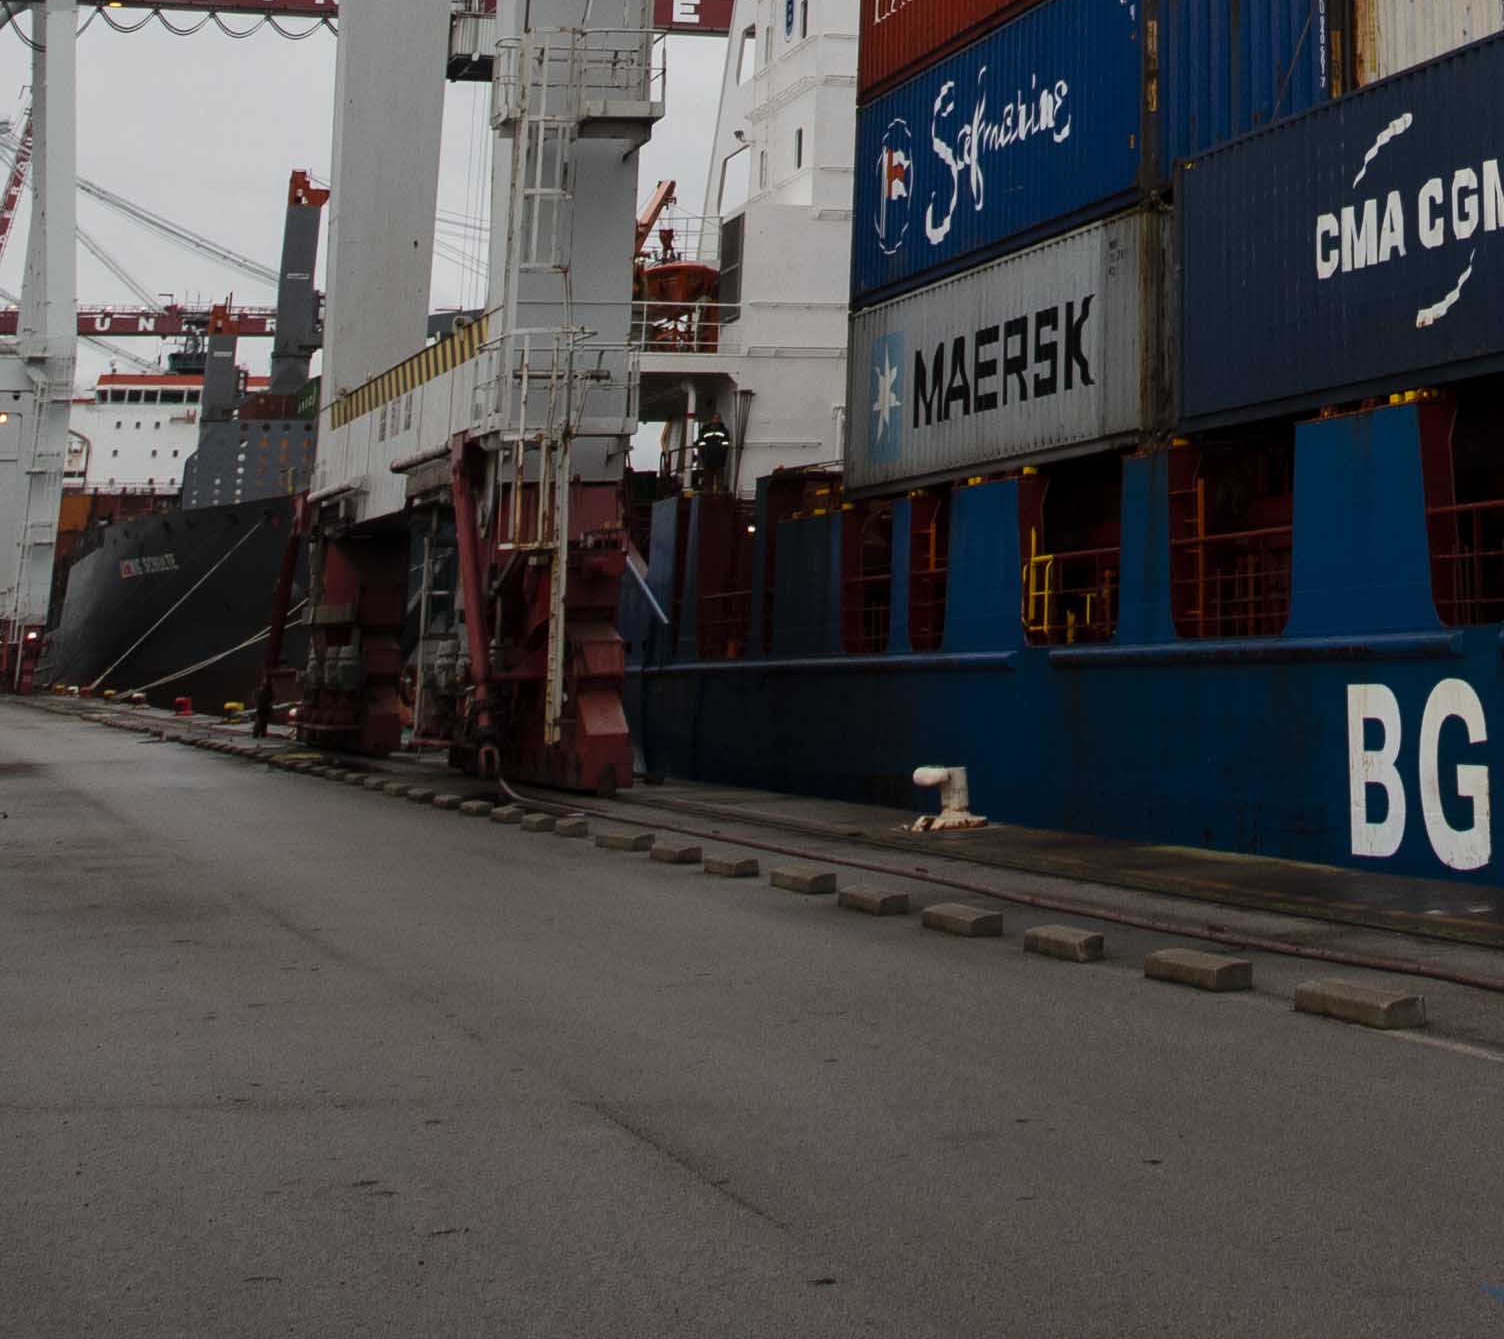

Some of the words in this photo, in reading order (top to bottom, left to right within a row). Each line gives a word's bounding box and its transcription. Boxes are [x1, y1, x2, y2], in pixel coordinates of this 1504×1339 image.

[1316, 191, 1404, 280] CMA
[913, 294, 1095, 427] MAERSK
[1346, 677, 1492, 871] BG
